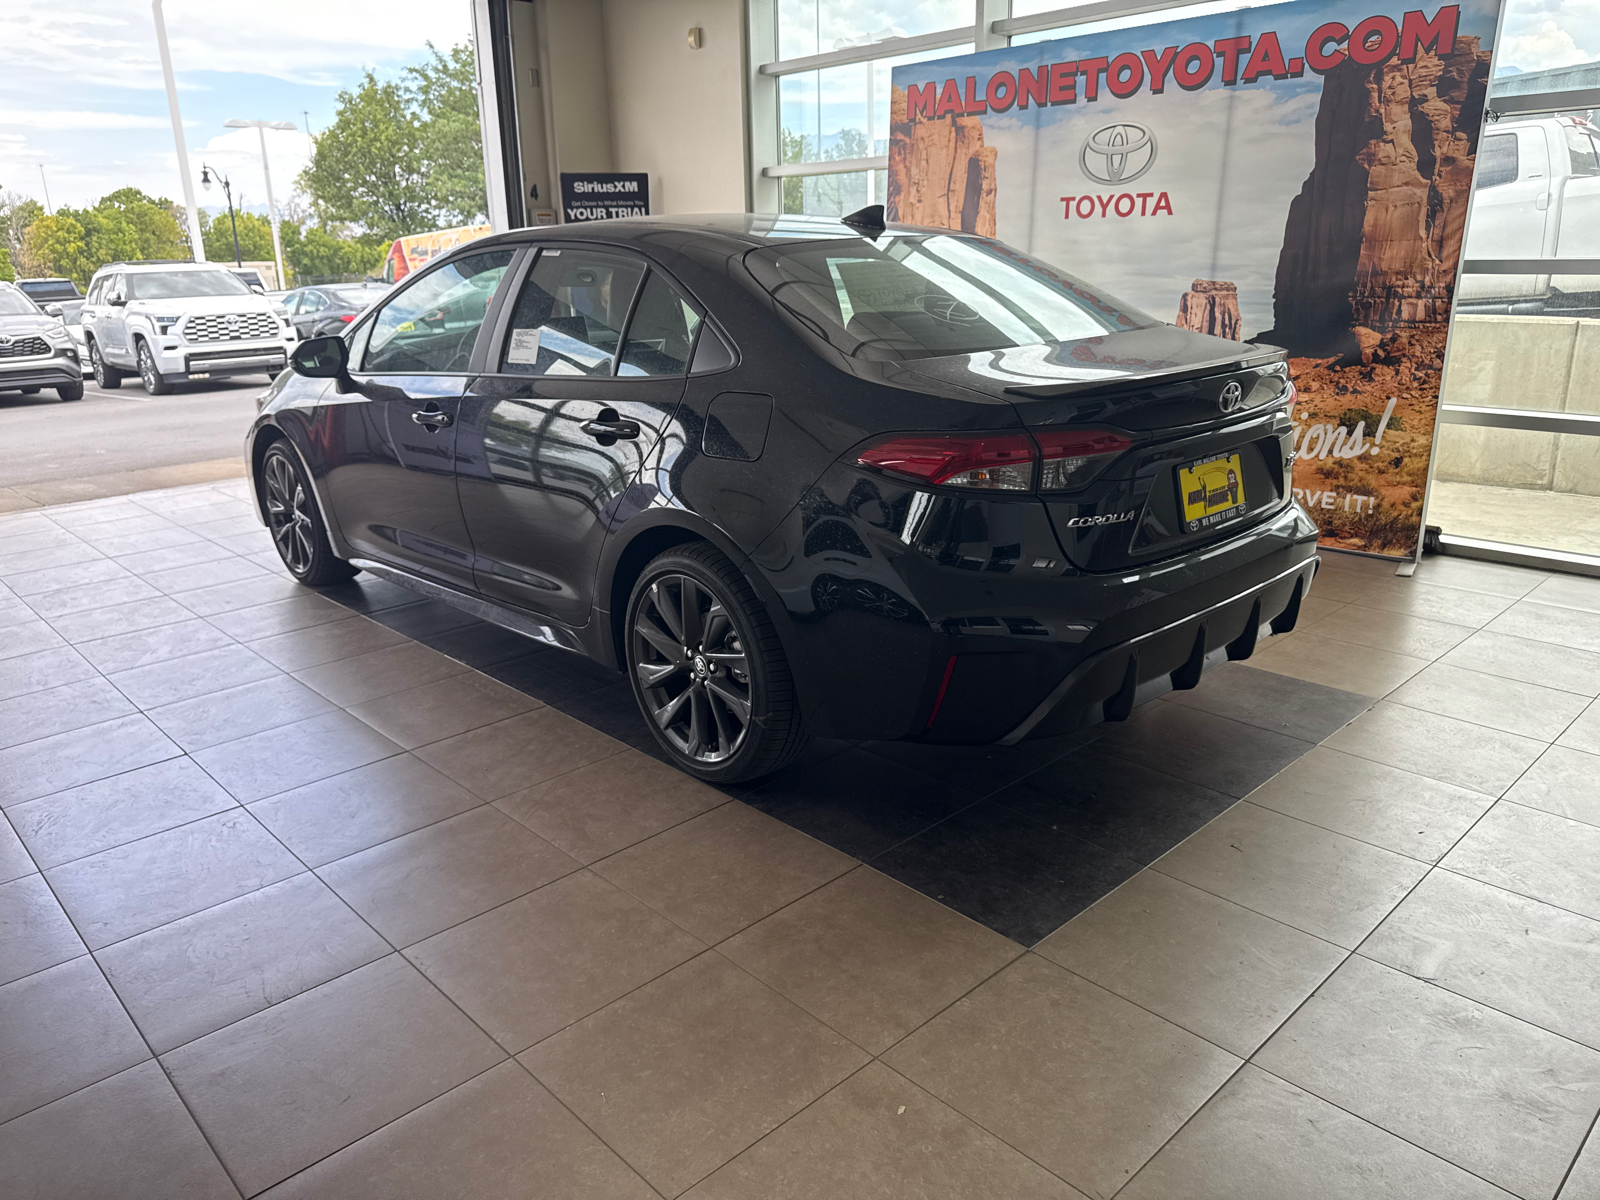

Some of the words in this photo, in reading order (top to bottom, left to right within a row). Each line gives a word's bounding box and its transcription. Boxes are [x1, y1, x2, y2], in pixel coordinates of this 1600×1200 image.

[907, 4, 1461, 122] MALONETOYOTA.COM
[530, 184, 539, 201] 4
[573, 181, 638, 193] SiriusXM
[567, 207, 607, 220] YOUR
[1060, 191, 1174, 220] TOYOTA
[1228, 474, 1235, 483] 32
[1344, 493, 1375, 514] IT!
[1066, 510, 1135, 528] COROLLA
[1201, 518, 1209, 526] WE
[1210, 515, 1221, 523] MAKE
[1226, 508, 1236, 517] EASY
